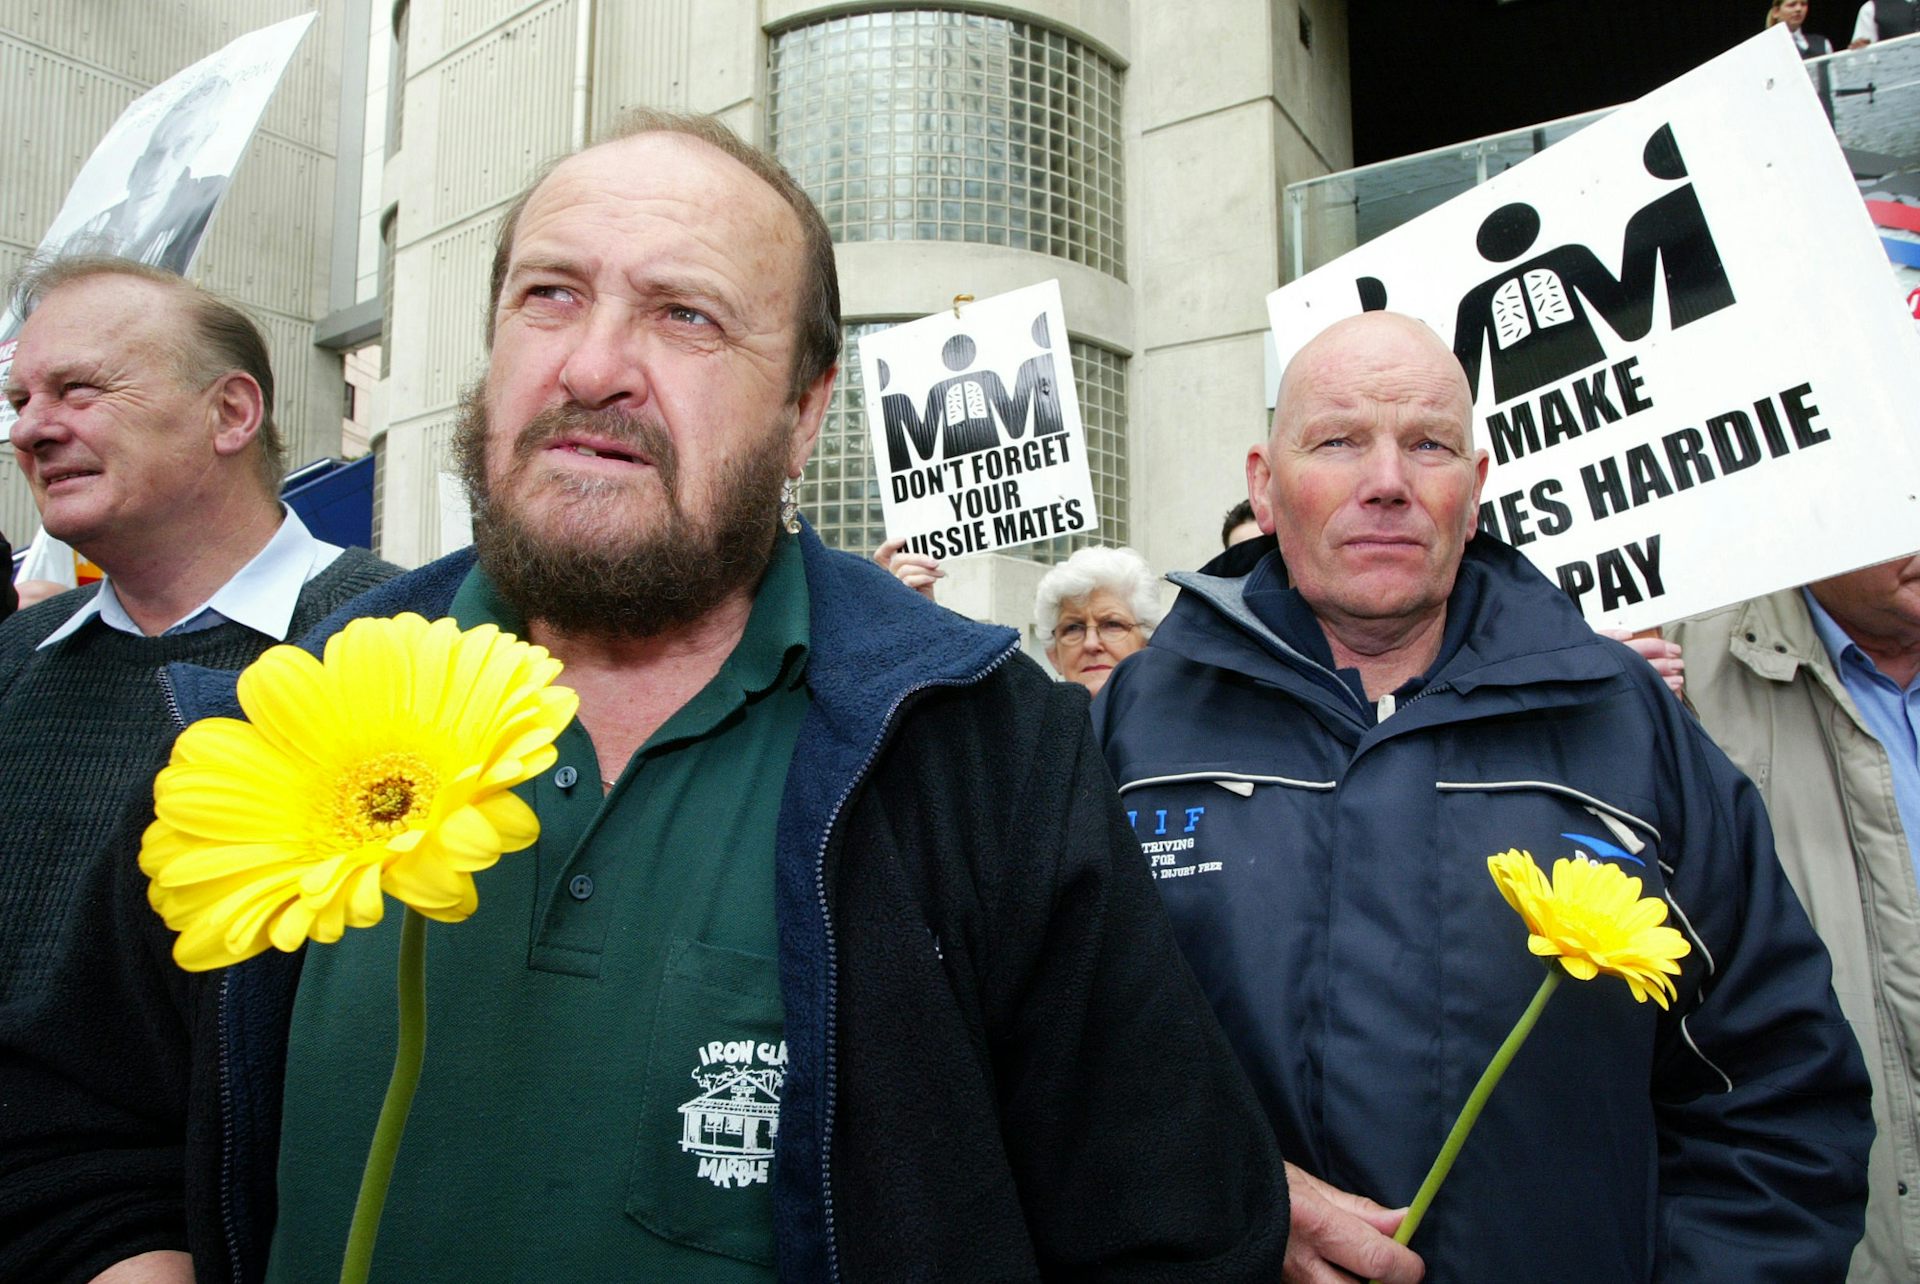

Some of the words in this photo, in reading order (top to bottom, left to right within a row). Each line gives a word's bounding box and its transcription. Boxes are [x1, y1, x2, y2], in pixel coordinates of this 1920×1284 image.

[1486, 355, 1654, 466] MAKE
[891, 459, 964, 504] DON'T
[971, 432, 1070, 484] FORGET
[1580, 382, 1831, 521] HARDIE
[948, 479, 1022, 522] YOUR
[993, 498, 1084, 546] MATES
[1556, 534, 1666, 618] PAY
[1151, 853, 1176, 867] FOR
[1160, 866, 1196, 879] INJURY
[1198, 862, 1222, 873] FREE
[698, 1039, 755, 1066] IRON
[697, 1158, 769, 1188] MARBLE
